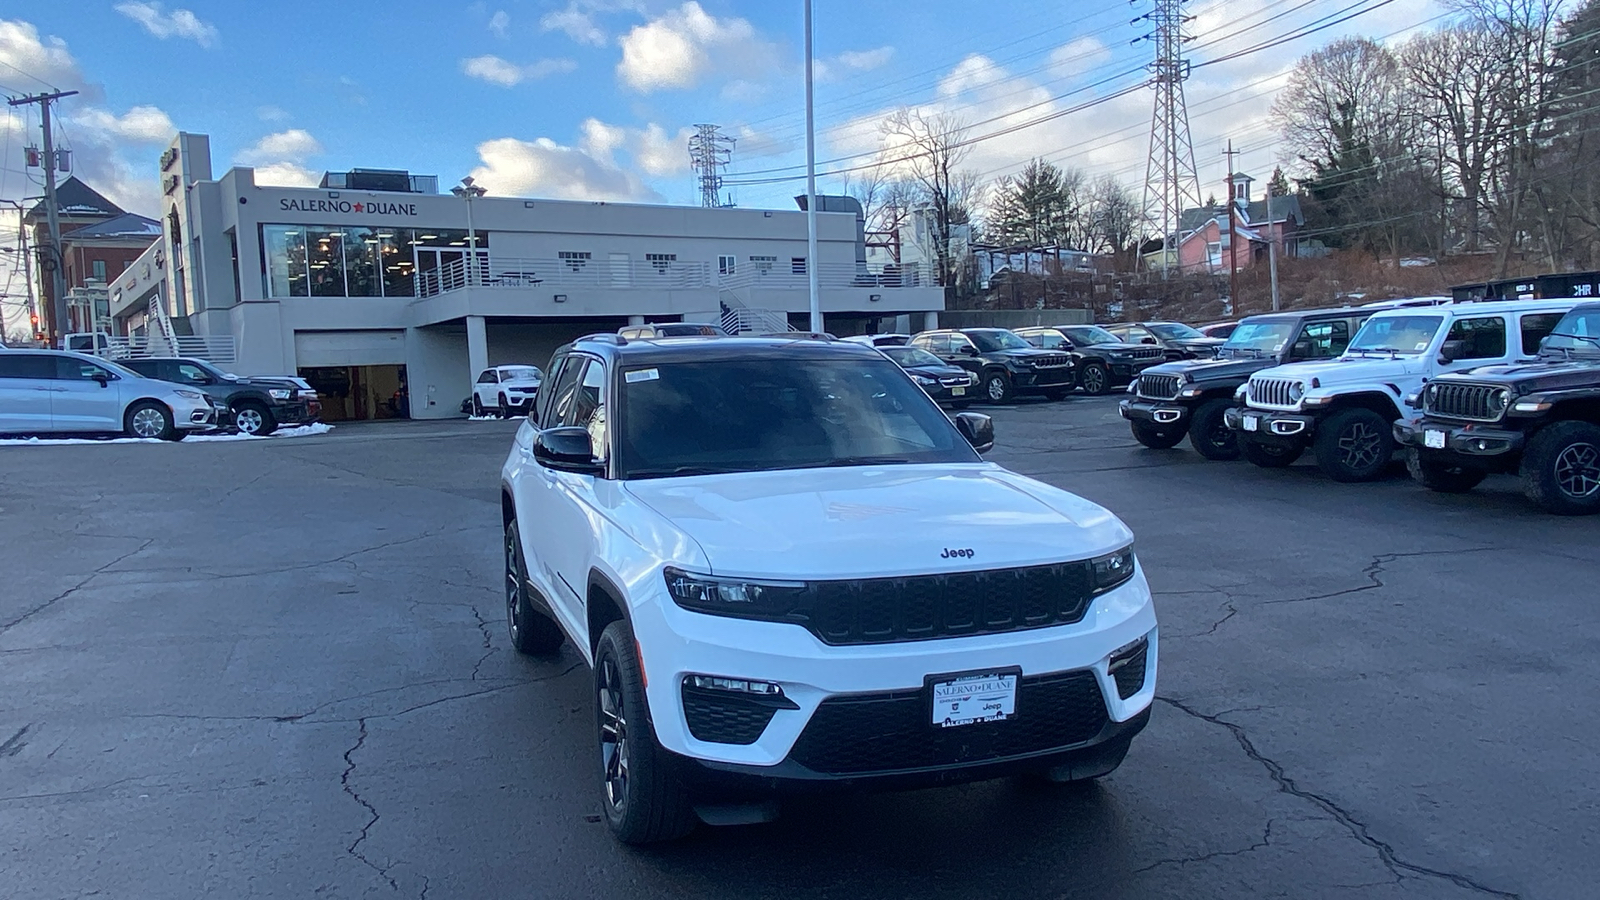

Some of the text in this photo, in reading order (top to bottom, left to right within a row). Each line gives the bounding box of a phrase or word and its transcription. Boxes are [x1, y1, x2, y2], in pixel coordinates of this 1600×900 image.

[279, 198, 418, 216] SALERNO DUANE
[940, 547, 975, 559] Jeep
[935, 684, 977, 696] SALERNO
[982, 681, 1014, 692] DUANE
[982, 703, 1002, 711] Jeep
